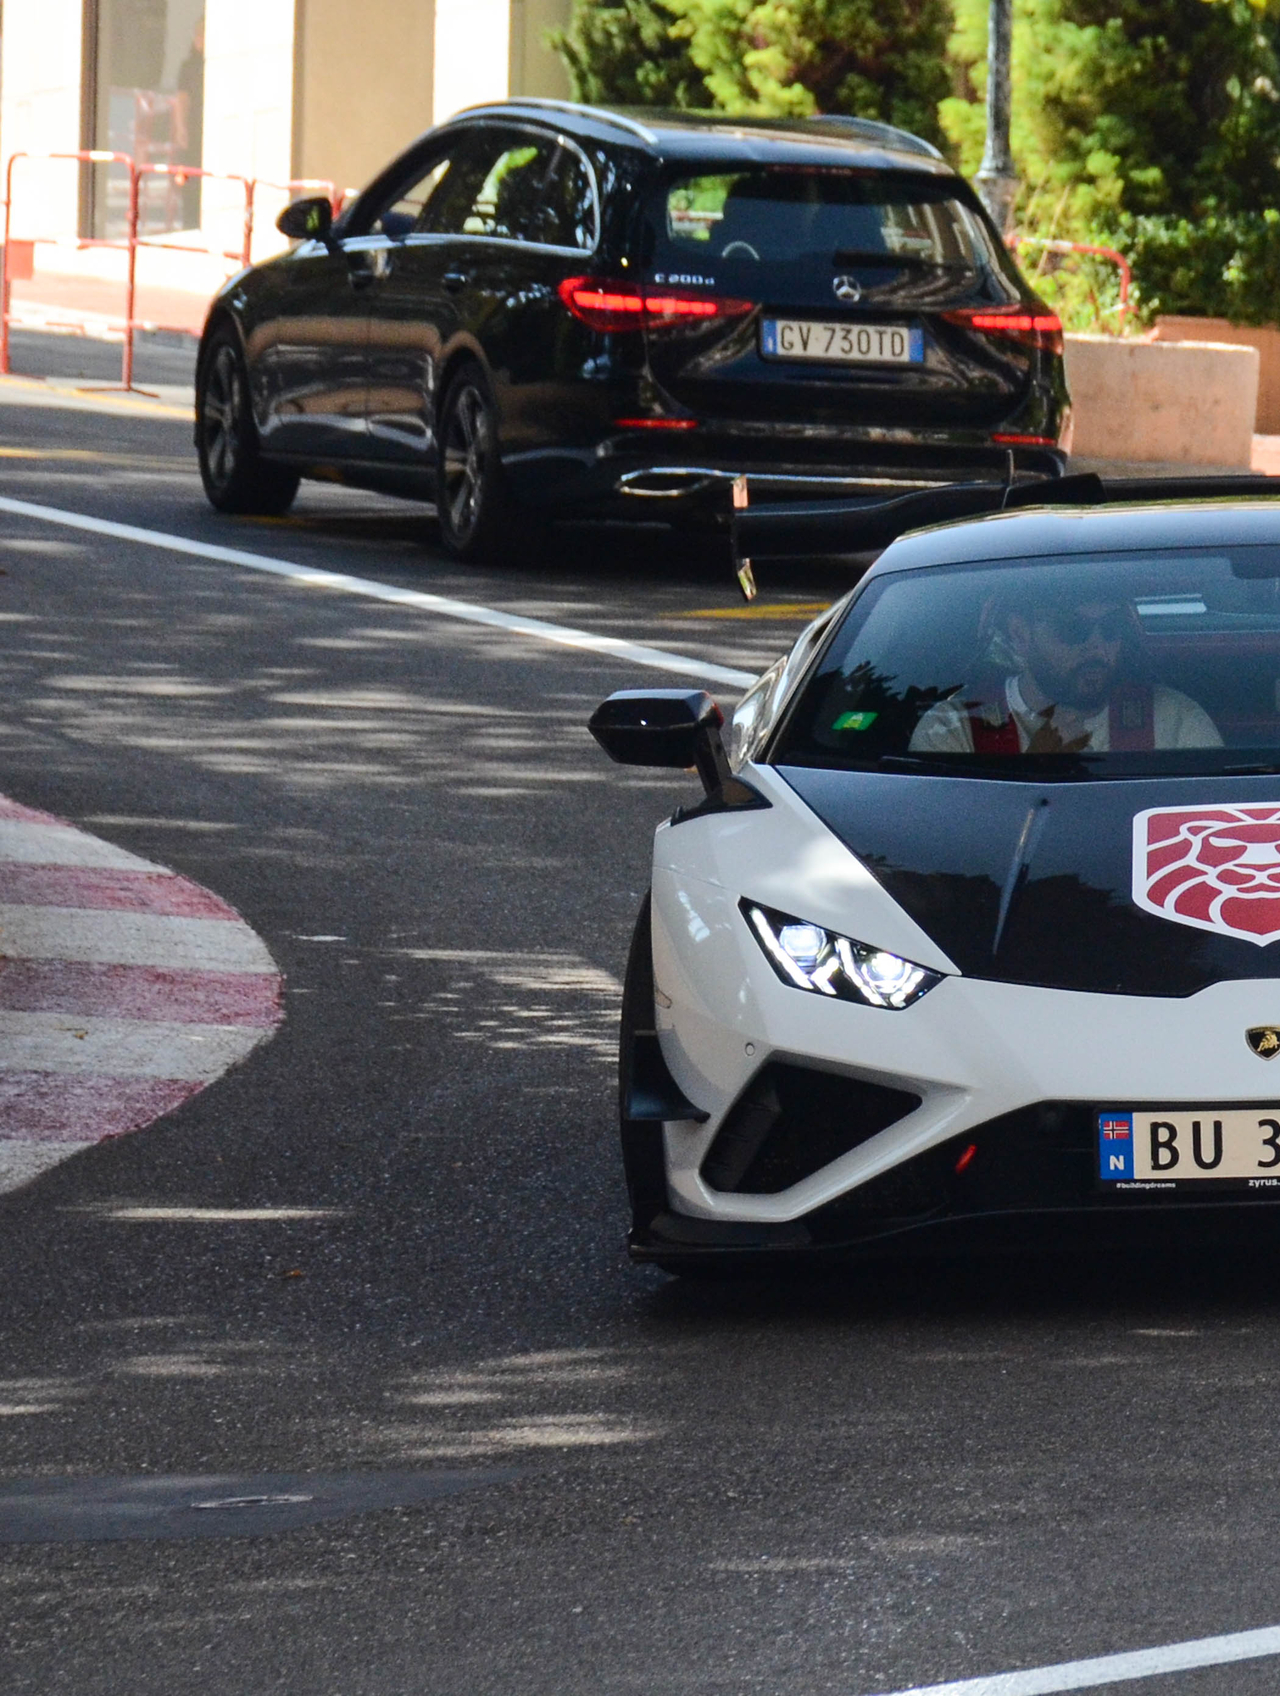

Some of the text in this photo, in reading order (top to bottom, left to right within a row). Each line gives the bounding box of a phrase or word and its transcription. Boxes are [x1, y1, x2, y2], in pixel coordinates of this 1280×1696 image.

[780, 324, 905, 357] GV 730TD
[1150, 1120, 1223, 1171] BU
[1109, 1155, 1125, 1171] N
[1115, 1181, 1176, 1190] #buildingdreams
